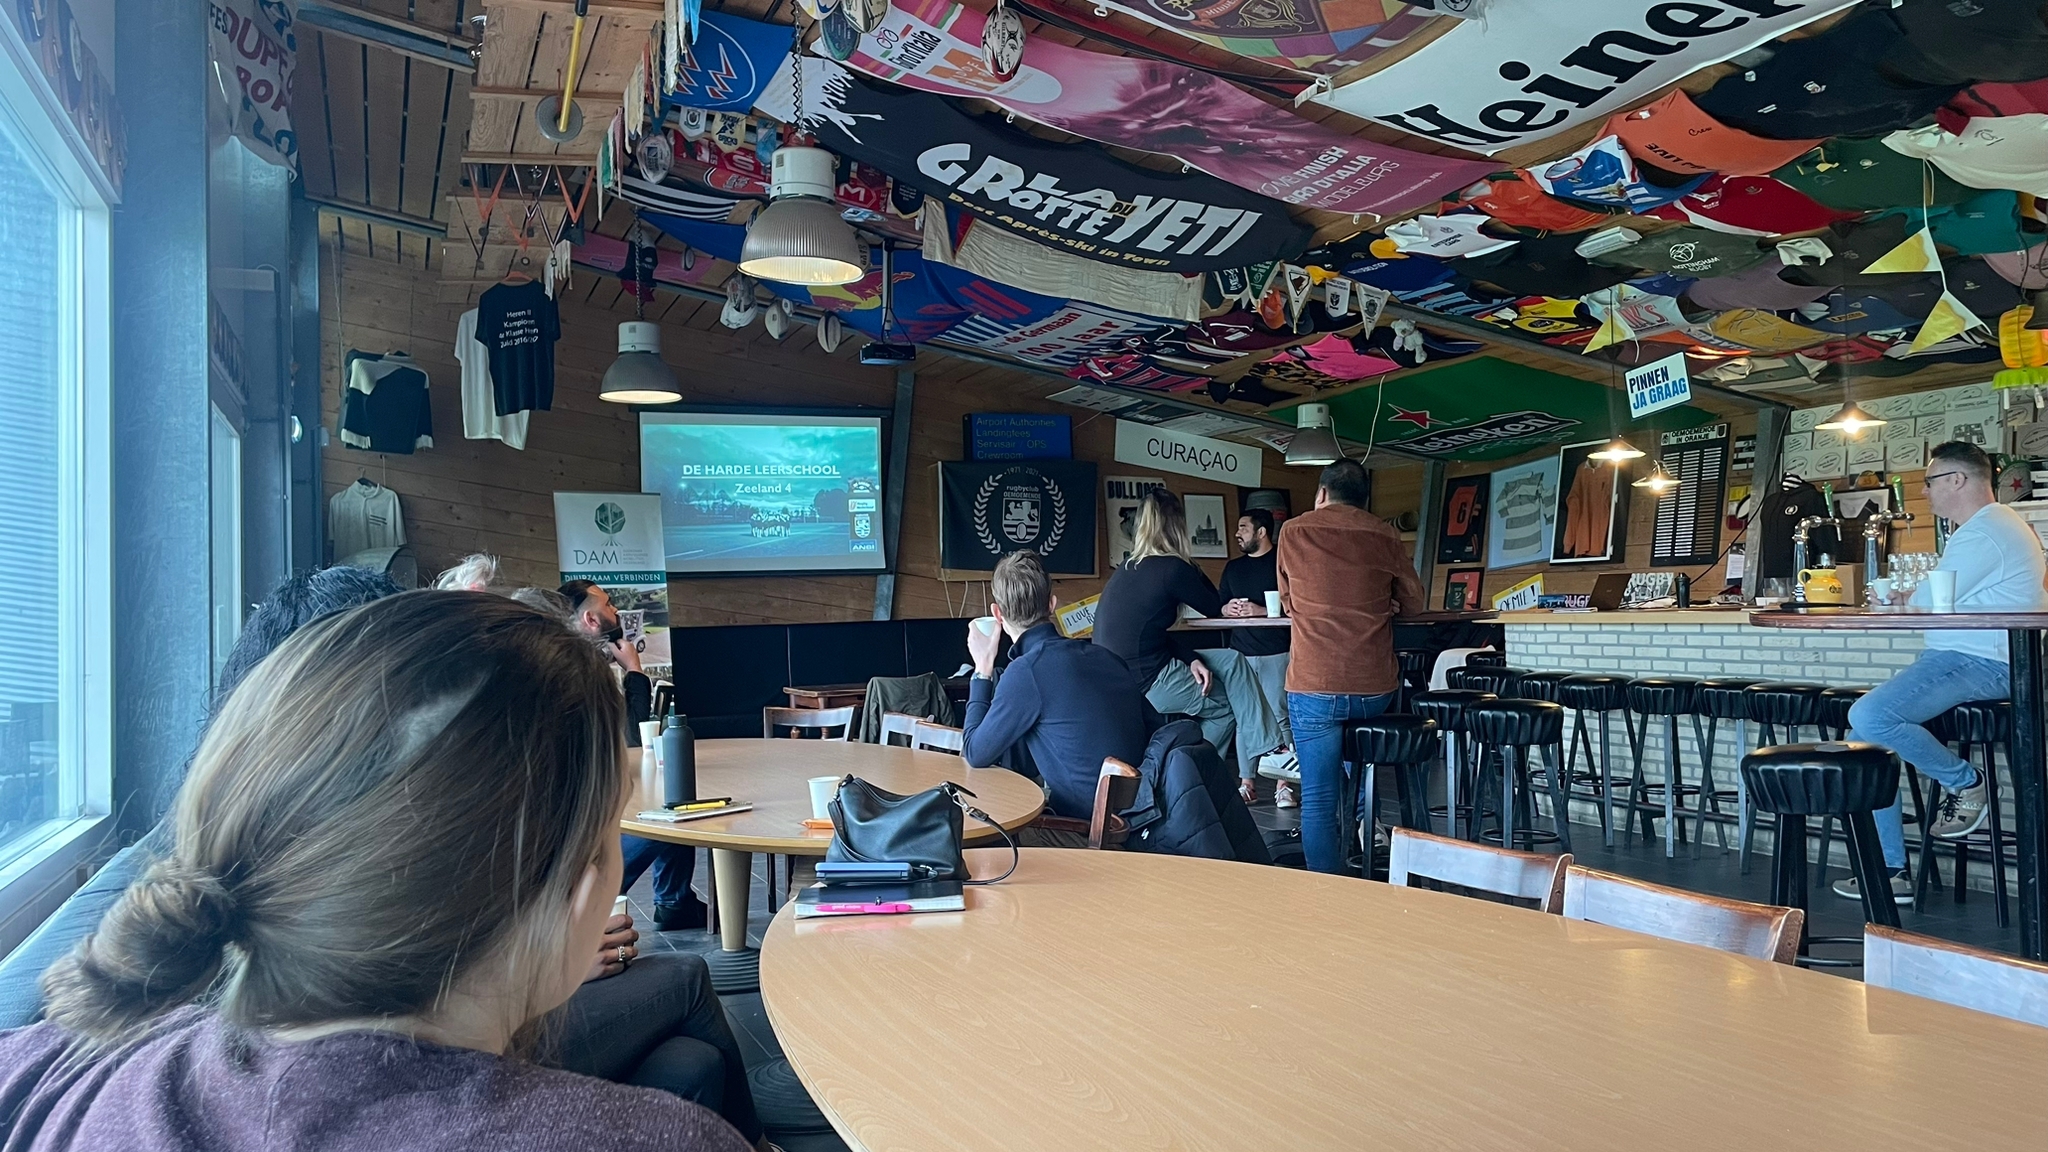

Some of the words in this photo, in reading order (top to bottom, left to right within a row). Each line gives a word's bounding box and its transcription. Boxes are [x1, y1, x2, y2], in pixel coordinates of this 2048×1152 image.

[1374, 0, 1814, 146] Heine
[1293, 146, 1349, 178] FINISH
[1310, 160, 1400, 208] MIDDELBURG
[1282, 186, 1320, 204] GIRO
[1106, 202, 1139, 218] DU
[1103, 194, 1263, 257] YETI
[1099, 247, 1120, 258] in
[1123, 253, 1172, 268] Town
[1671, 256, 1720, 270] NOTTINGHAM
[1689, 264, 1712, 272] RUGBY
[506, 310, 526, 318] Heren
[1019, 312, 1082, 338] Germaan
[1017, 343, 1066, 357] 100
[1057, 321, 1121, 344] jaar
[1629, 365, 1670, 394] PINNEN
[1632, 392, 1648, 410] JA
[1648, 377, 1688, 404] GRAAG
[976, 417, 1006, 427] Airport
[1010, 418, 1056, 427] Authorities
[976, 429, 1031, 438] Landingfees
[1396, 416, 1560, 453] Heineken
[1684, 433, 1710, 443] ORANJE
[977, 440, 1016, 448] Servisair
[1027, 440, 1047, 448] OPS
[977, 451, 1024, 459] Crewroom
[1147, 438, 1238, 473] CURAÇAO
[682, 465, 701, 475] DE
[705, 465, 751, 475] HARDE
[755, 465, 840, 475] LEERSCHOOL
[735, 483, 782, 493] Zeeland
[785, 483, 792, 493] 4
[573, 549, 619, 565] DAM
[613, 573, 661, 581] VERBINDEN
[1066, 617, 1073, 627] I
[1071, 606, 1090, 624] LOVE
